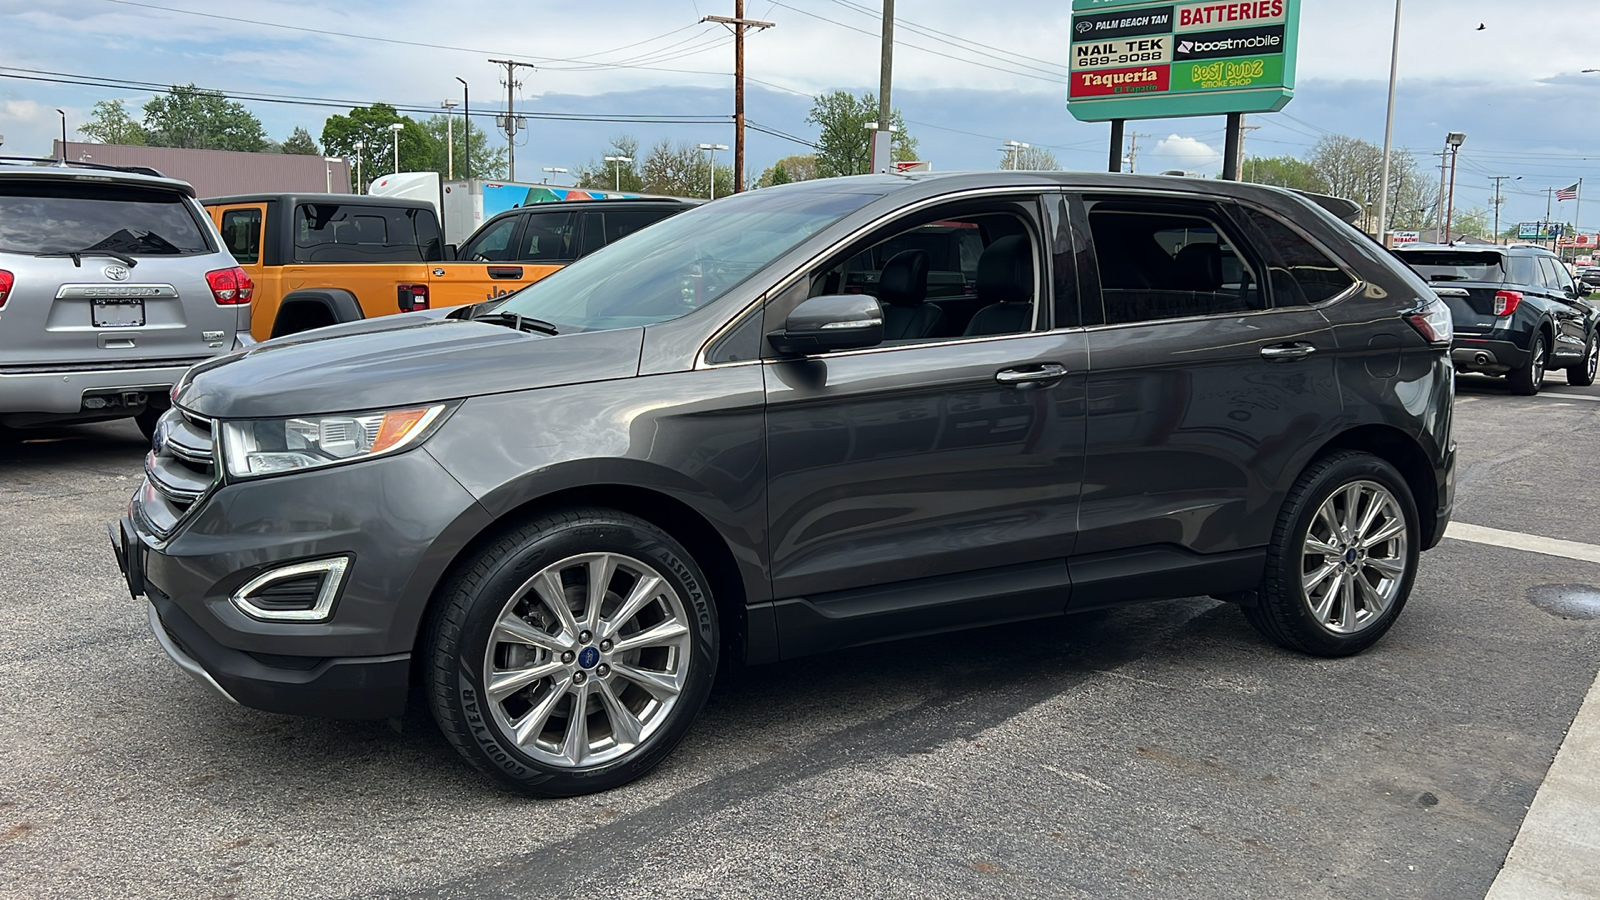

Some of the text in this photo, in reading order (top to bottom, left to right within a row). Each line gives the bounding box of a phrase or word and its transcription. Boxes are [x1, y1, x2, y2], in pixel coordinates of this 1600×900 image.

[1095, 14, 1168, 31] PALM BEACH TAN
[1180, 0, 1283, 26] BATTERIES
[1077, 38, 1163, 57] NAIL TEK
[1078, 51, 1162, 67] 689-9088
[1201, 78, 1252, 89] SMOKE SHOP
[659, 552, 710, 633] ASSURANCE
[463, 689, 526, 776] GOODYEAR
